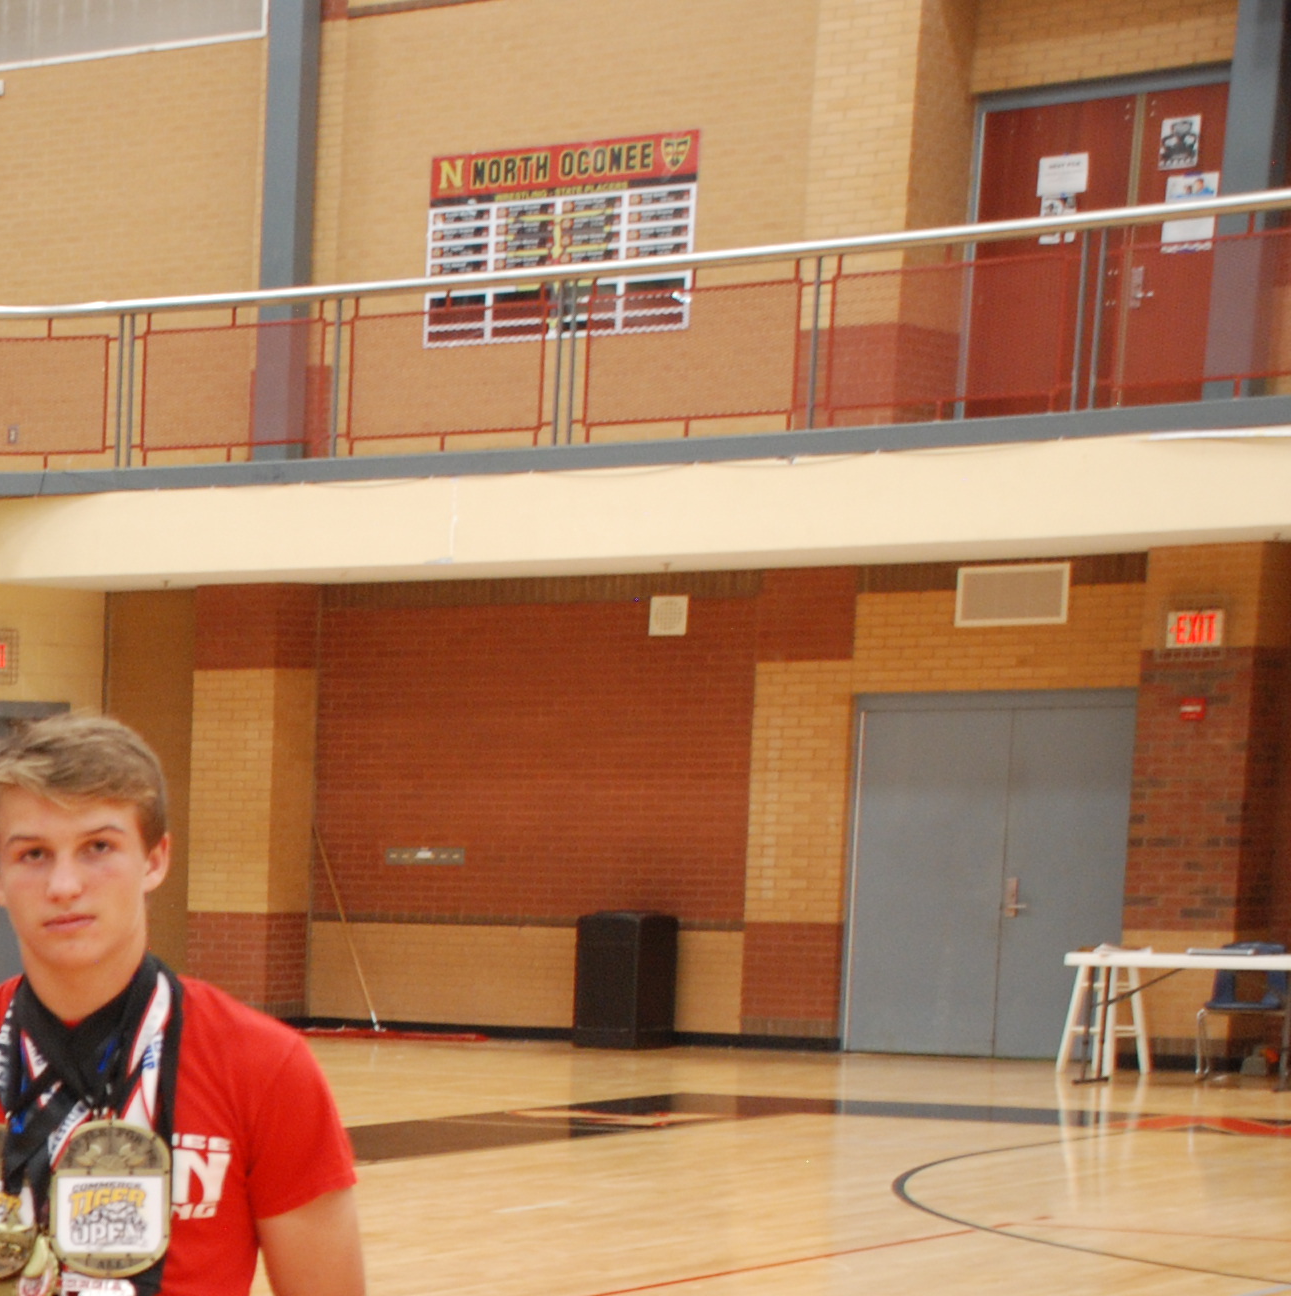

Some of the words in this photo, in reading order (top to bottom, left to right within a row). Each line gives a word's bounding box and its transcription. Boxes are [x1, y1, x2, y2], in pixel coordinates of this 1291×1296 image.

[471, 152, 551, 189] NORTH
[559, 140, 654, 179] OCONEE
[1175, 613, 1217, 645] EXIT
[70, 1190, 147, 1217] TIGER
